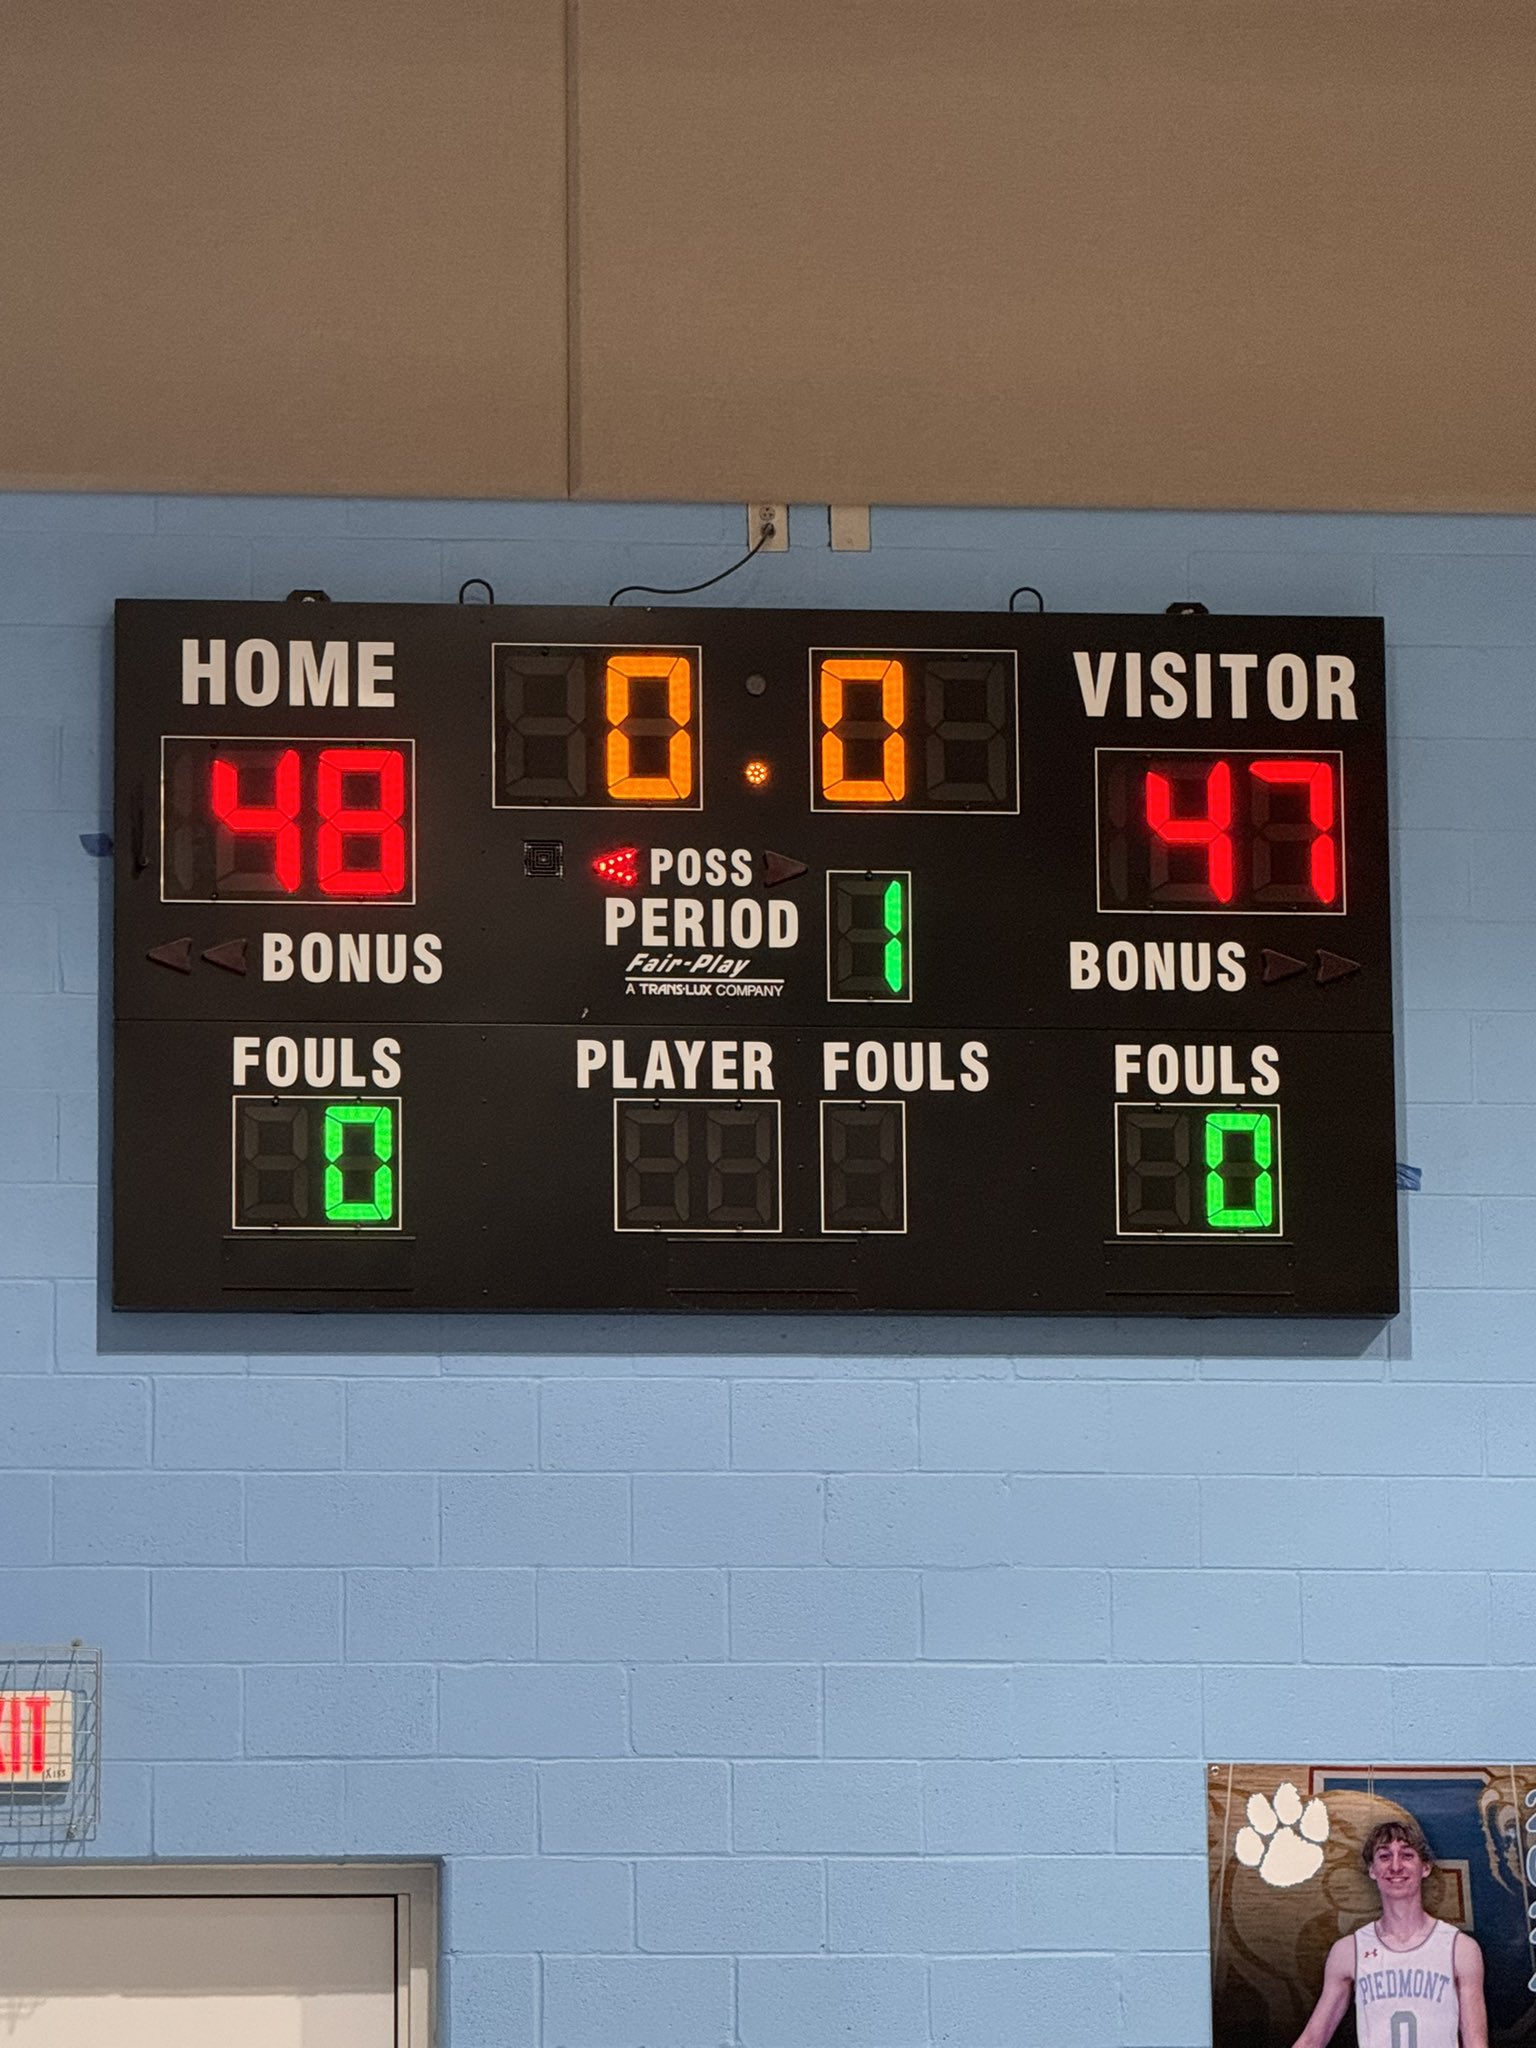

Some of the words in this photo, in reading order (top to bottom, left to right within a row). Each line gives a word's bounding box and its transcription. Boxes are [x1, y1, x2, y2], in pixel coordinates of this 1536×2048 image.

[181, 638, 396, 708] HOME
[1072, 651, 1359, 721] VISITOR
[605, 655, 692, 800] 0
[820, 659, 906, 802] 0
[211, 748, 405, 895] 48
[1145, 760, 1336, 904] 47
[650, 847, 753, 887] POSS
[605, 896, 799, 949] PERIOD
[883, 880, 903, 993] 1
[262, 932, 443, 985] BONUS
[625, 952, 752, 978] Fair-Play
[1069, 941, 1247, 992] BONUS
[625, 983, 636, 995] A
[715, 984, 784, 997] COMPANY
[232, 1036, 402, 1089] FOULS
[576, 1039, 775, 1091] PLAYER
[823, 1040, 990, 1092] FOULS
[1114, 1044, 1281, 1096] FOULS
[324, 1105, 393, 1222] 0
[1204, 1112, 1273, 1228] 0
[0, 1697, 50, 1773] IT
[1358, 1968, 1450, 2006] PIEDMONT
